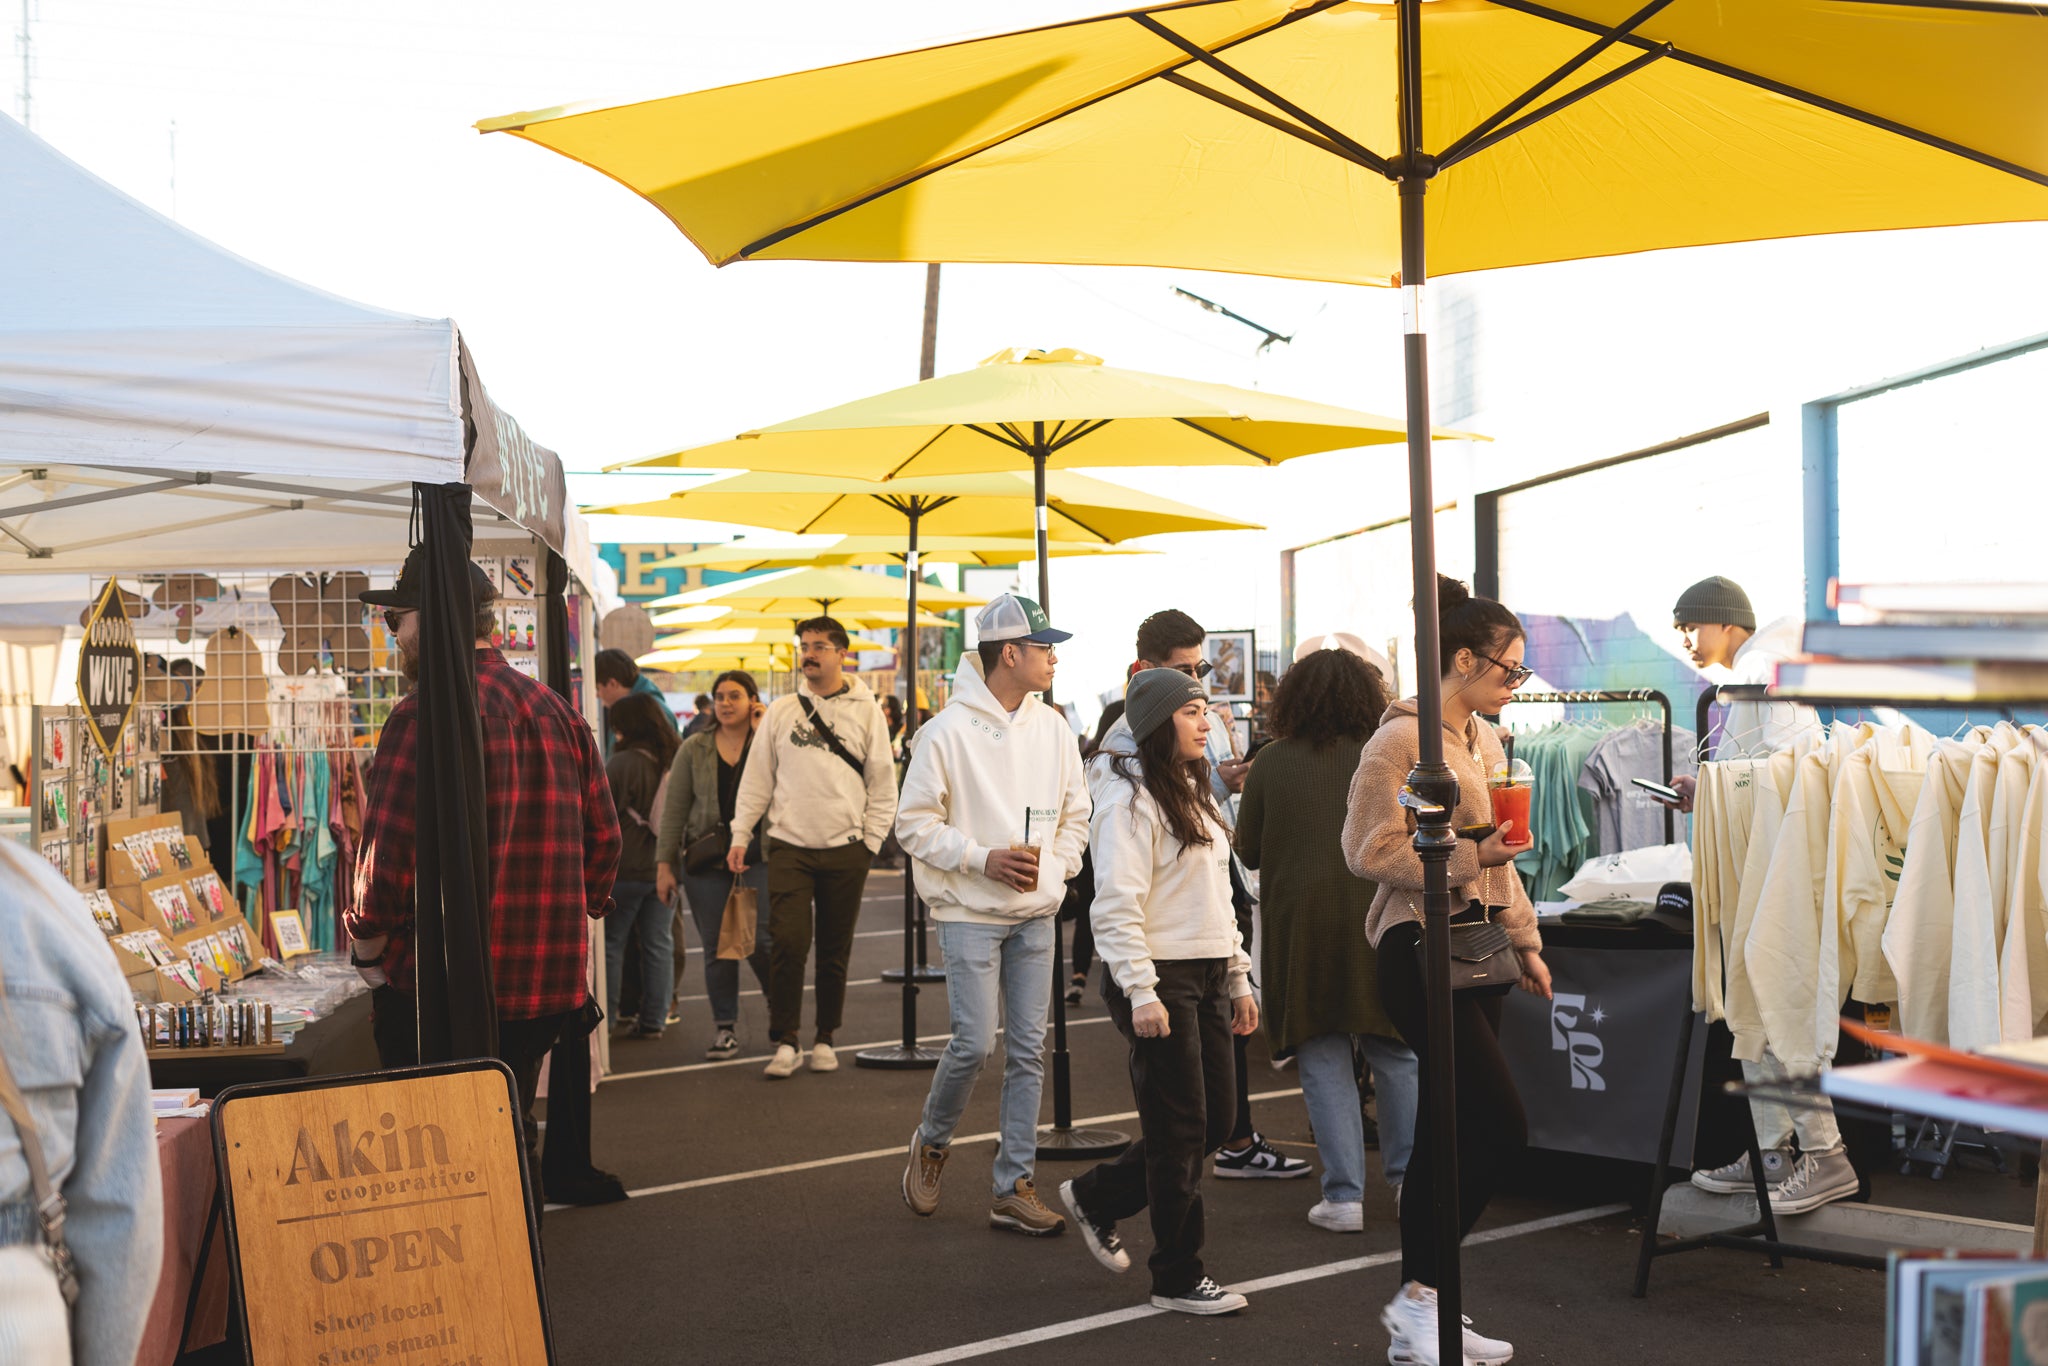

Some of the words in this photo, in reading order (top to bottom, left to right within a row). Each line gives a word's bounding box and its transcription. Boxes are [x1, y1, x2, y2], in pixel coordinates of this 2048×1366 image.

[89, 655, 133, 706] WUVE
[285, 1112, 450, 1186] Akin
[324, 1169, 477, 1203] cooperative
[310, 1224, 465, 1285] OPEN
[313, 1311, 377, 1336] shop
[381, 1296, 445, 1325] local
[318, 1342, 381, 1366] shop
[386, 1326, 458, 1356] small
